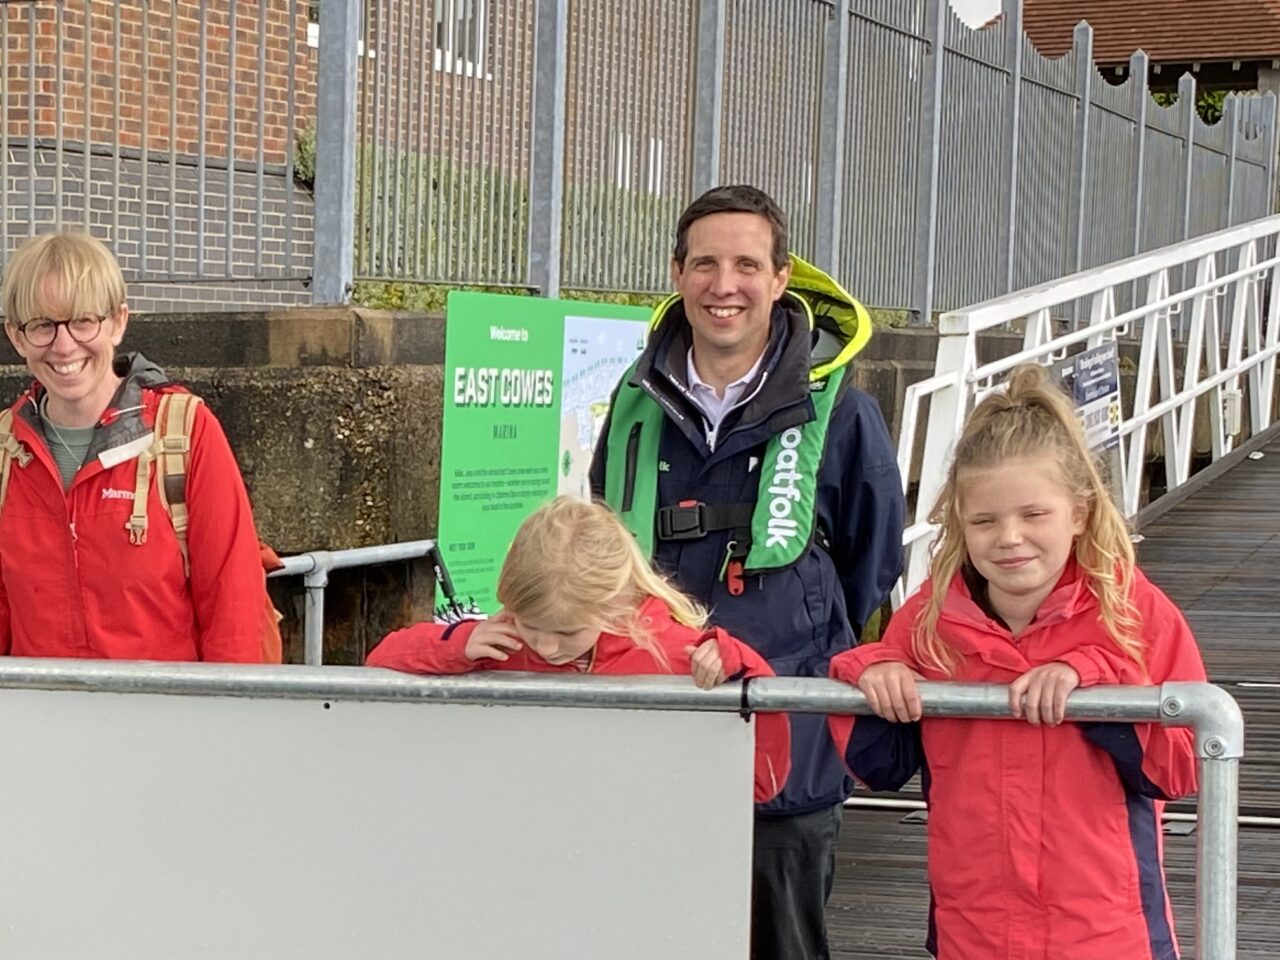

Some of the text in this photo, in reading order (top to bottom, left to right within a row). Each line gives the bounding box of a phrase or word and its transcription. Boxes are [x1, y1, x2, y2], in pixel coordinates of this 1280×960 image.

[489, 325, 529, 342] Welcome to
[454, 366, 554, 407] EAST COWES
[492, 424, 518, 440] MARINA
[101, 487, 134, 500] Marm
[766, 427, 804, 550] oatfolk
